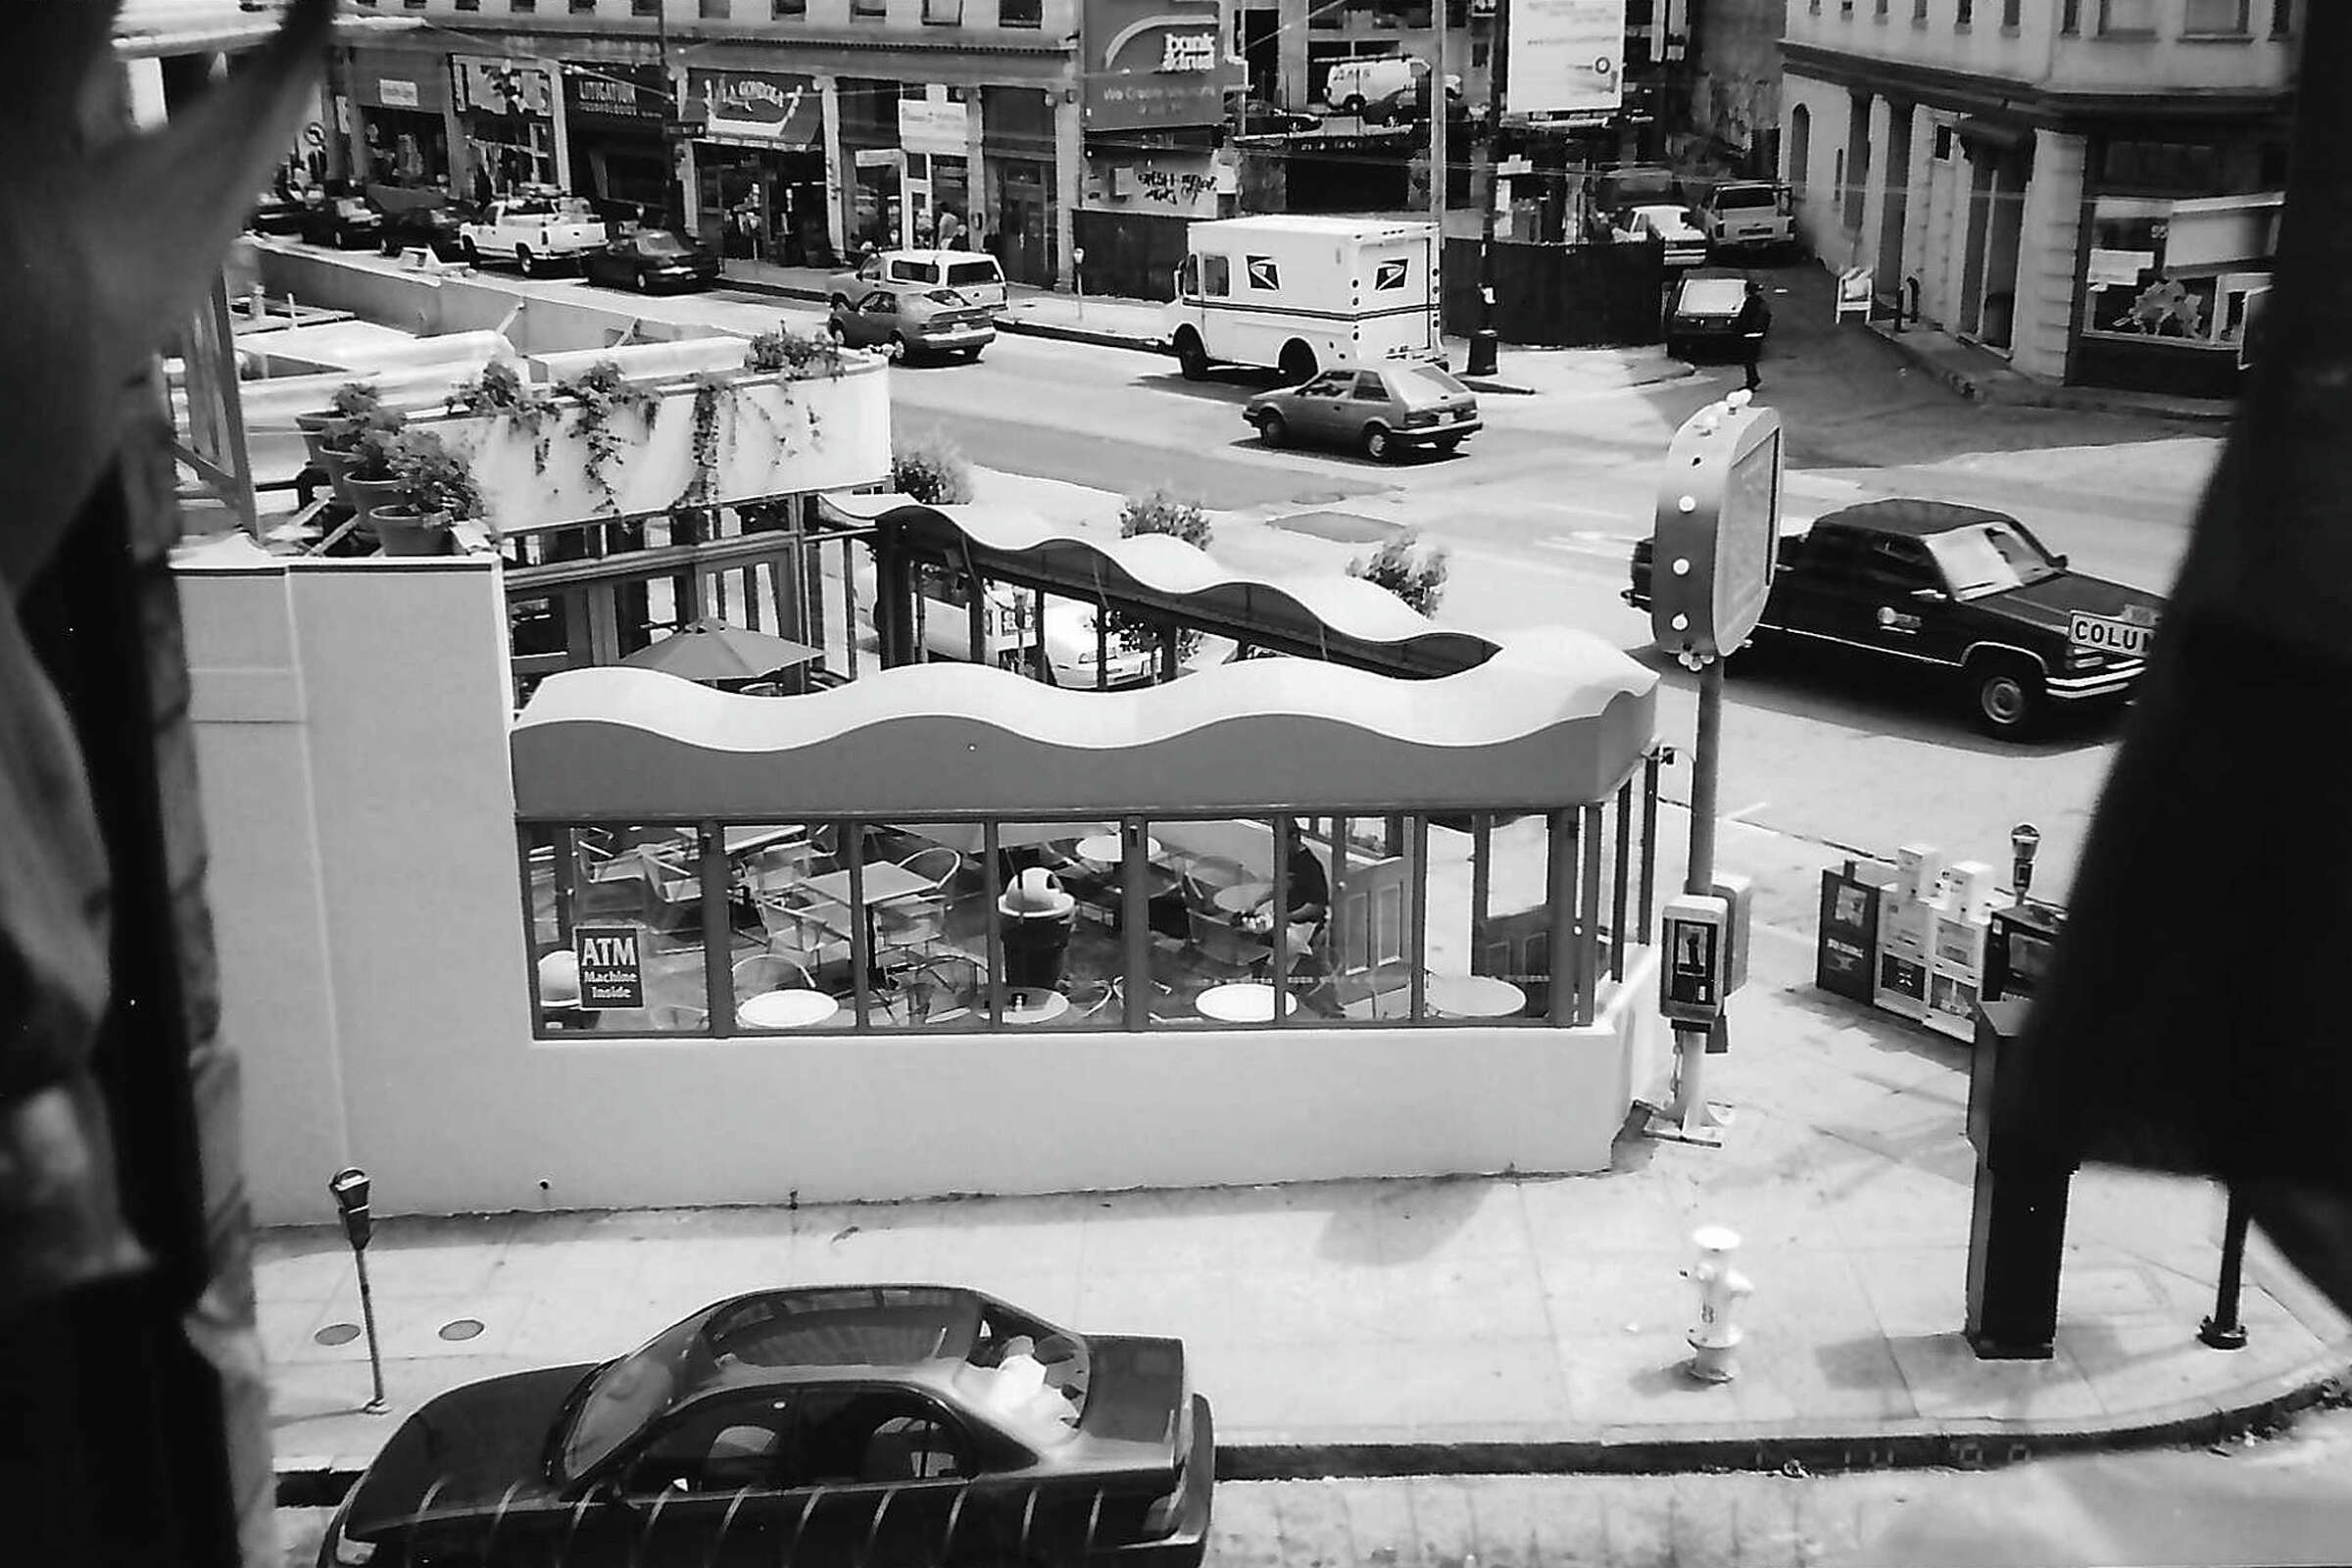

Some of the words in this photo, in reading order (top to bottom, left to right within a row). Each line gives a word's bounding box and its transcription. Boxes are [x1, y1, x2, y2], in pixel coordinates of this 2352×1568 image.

[581, 937, 637, 966] ATM
[583, 970, 638, 983] Machine
[591, 986, 633, 998] Inside
